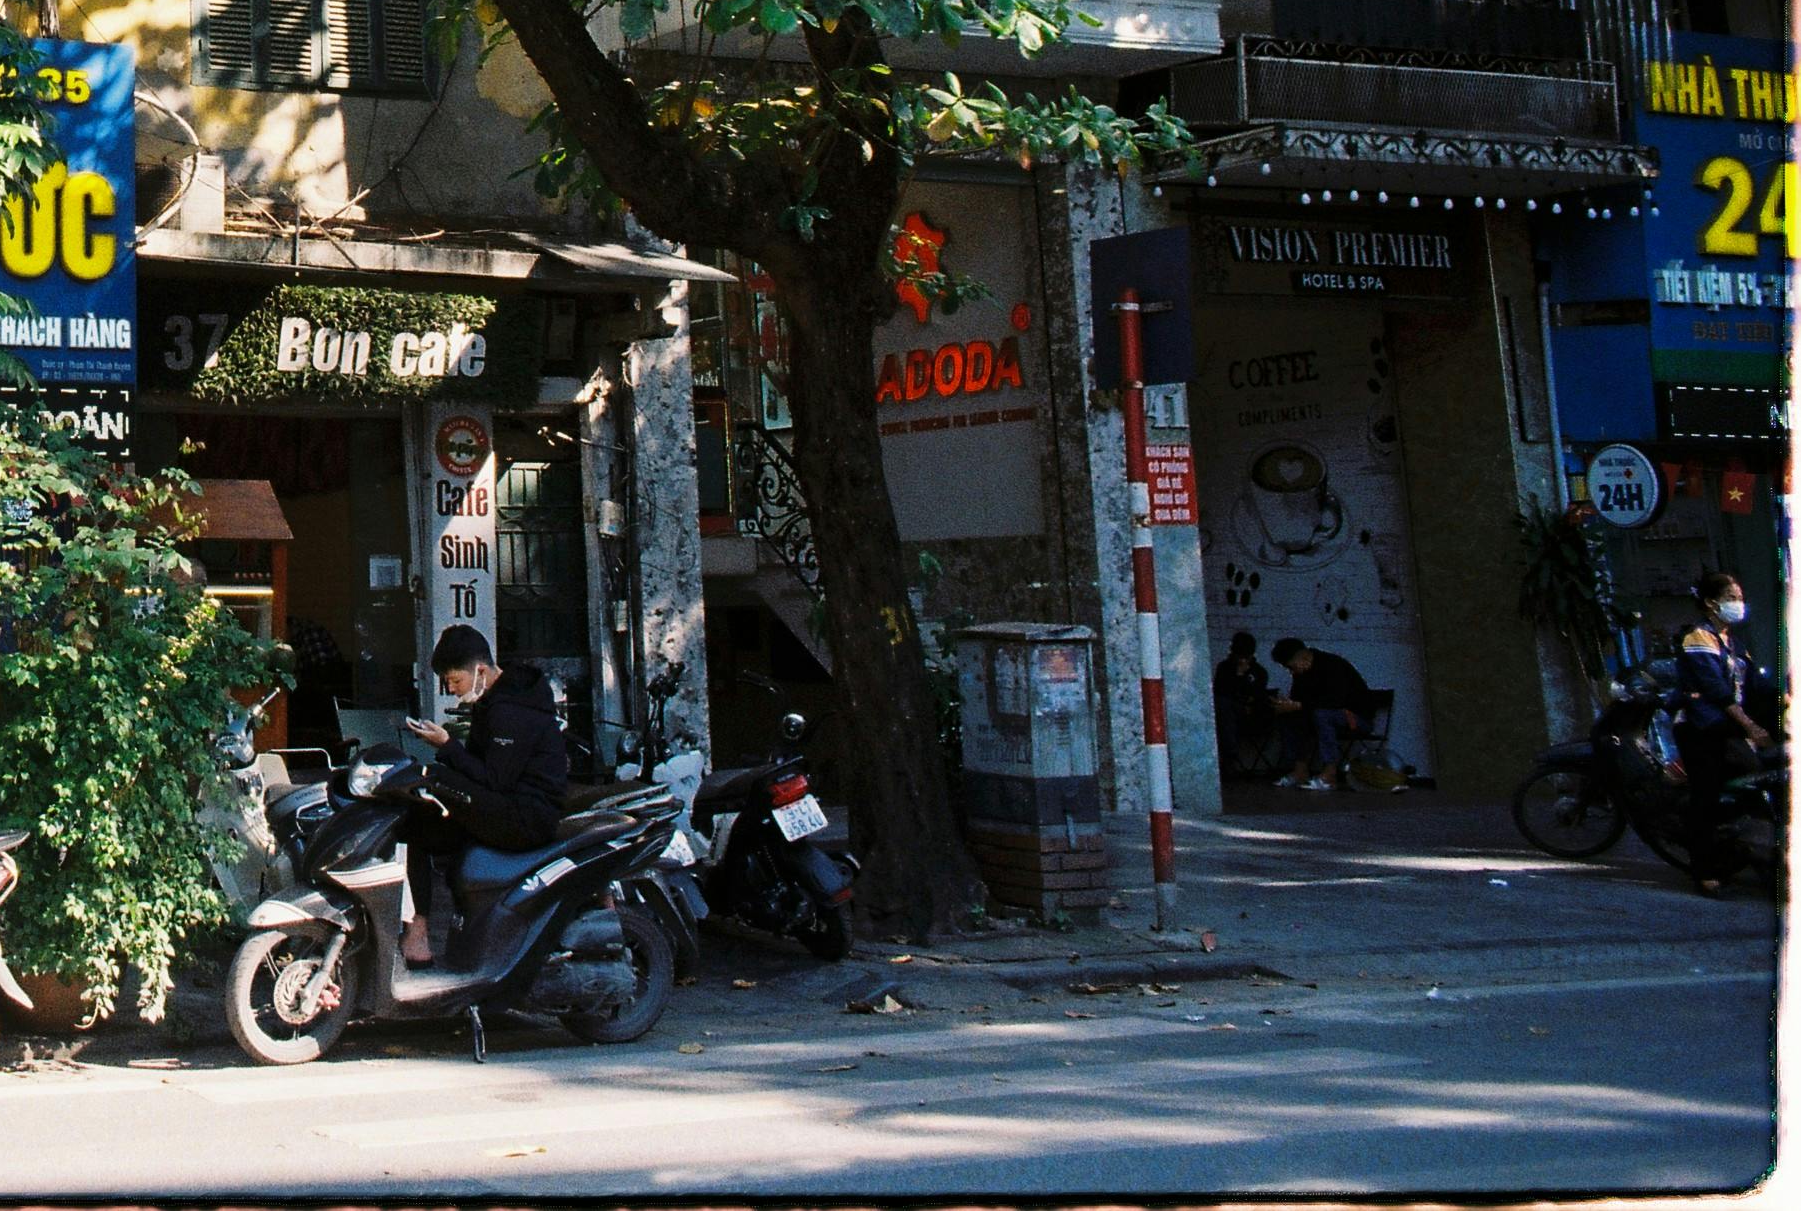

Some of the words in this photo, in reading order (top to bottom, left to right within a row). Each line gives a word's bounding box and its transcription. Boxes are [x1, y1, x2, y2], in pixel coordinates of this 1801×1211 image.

[35, 69, 90, 104] 35
[1650, 55, 1725, 116] NHÀ
[1230, 226, 1319, 263] VISION
[1334, 231, 1451, 269] PREMIER
[1302, 273, 1344, 289] HOTEL
[1348, 276, 1356, 289] &
[1359, 276, 1385, 290] SPA
[70, 312, 132, 349] HÀNG
[164, 313, 229, 371] 37
[277, 316, 372, 376] Bon
[390, 322, 487, 378] cafe
[875, 337, 1023, 403] ADODA
[1228, 350, 1319, 390] COFFEE
[1147, 390, 1190, 428] 41
[1238, 403, 1322, 428] COMPLIMENTS
[436, 478, 489, 517] Café
[1598, 483, 1645, 512] 24H
[440, 534, 489, 574] Sinh
[449, 578, 479, 619] Tố
